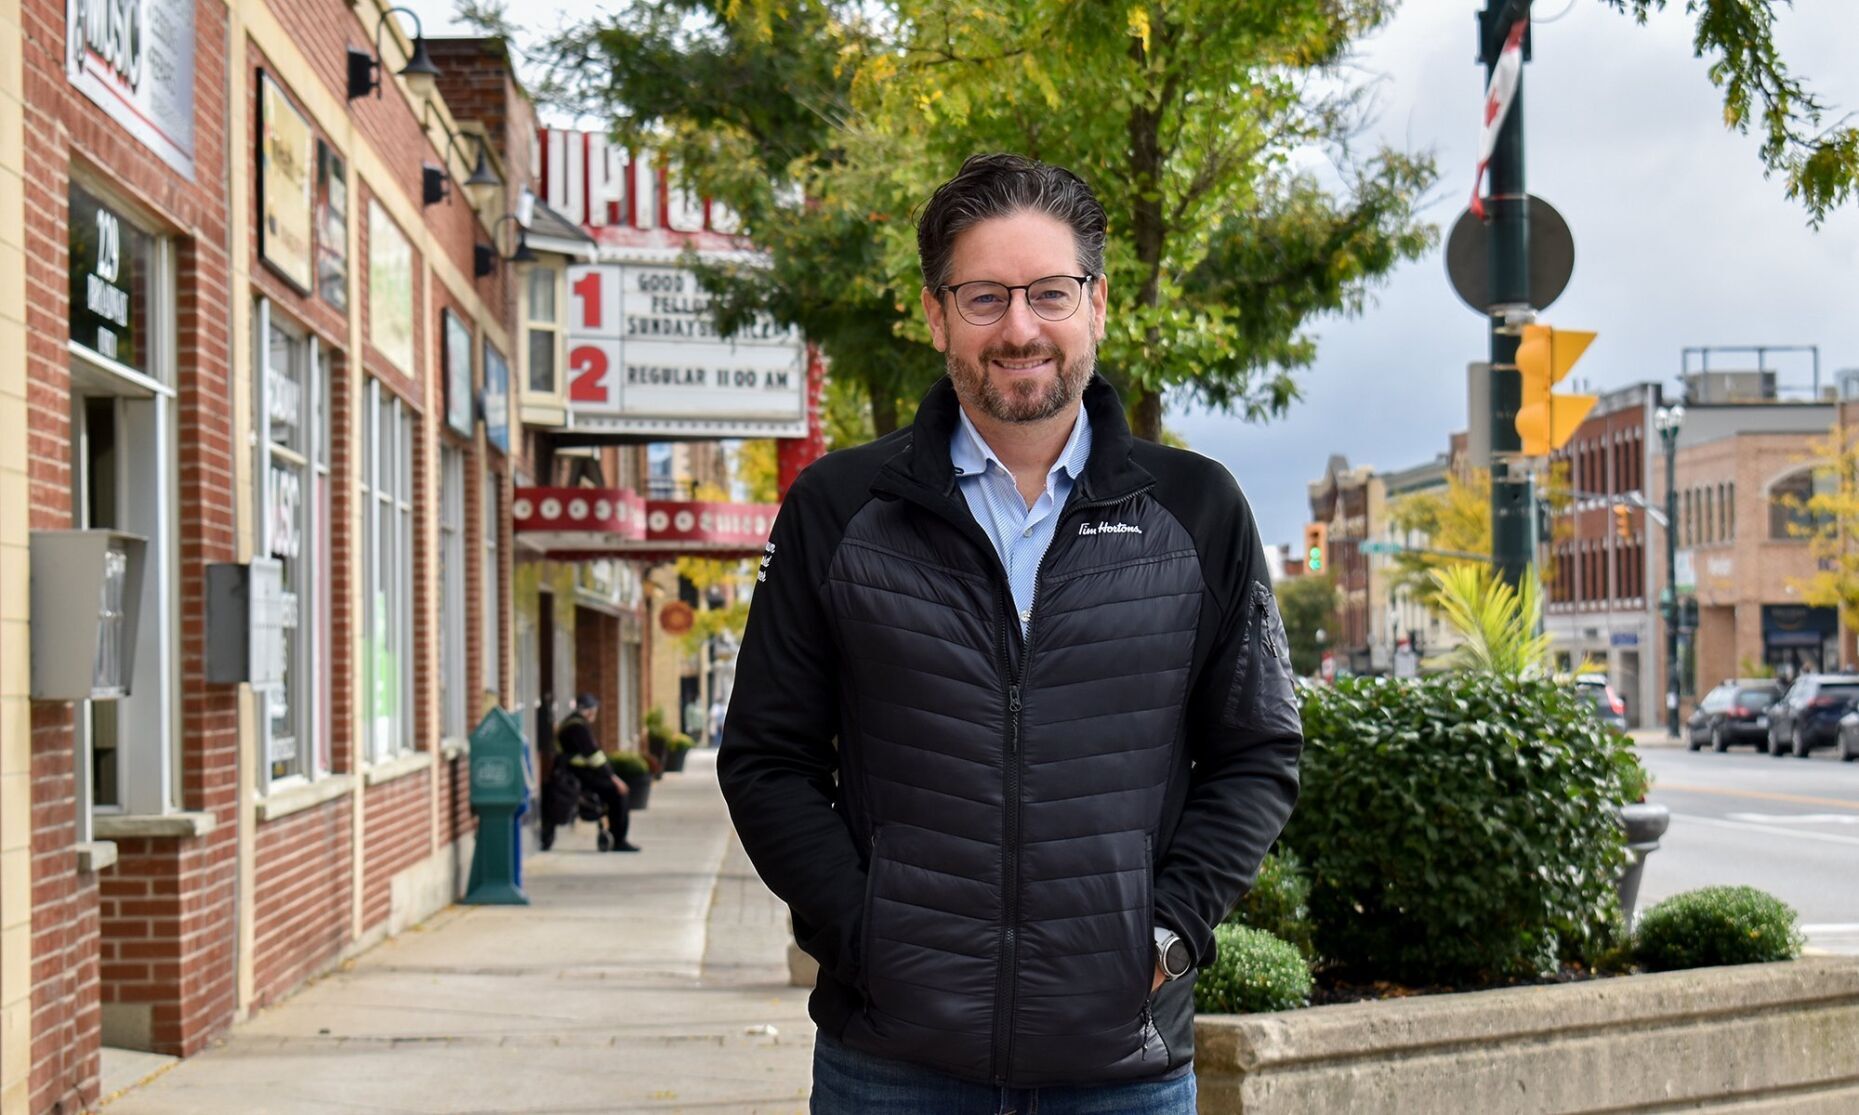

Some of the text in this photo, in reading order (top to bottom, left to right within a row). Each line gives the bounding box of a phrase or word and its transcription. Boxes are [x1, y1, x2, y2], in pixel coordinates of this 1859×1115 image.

[637, 273, 685, 292] GOOD
[573, 271, 602, 329] 1
[570, 345, 609, 404] 2
[627, 366, 706, 386] REGULAR
[764, 371, 789, 389] AM
[1078, 520, 1142, 536] Tim Hortons
